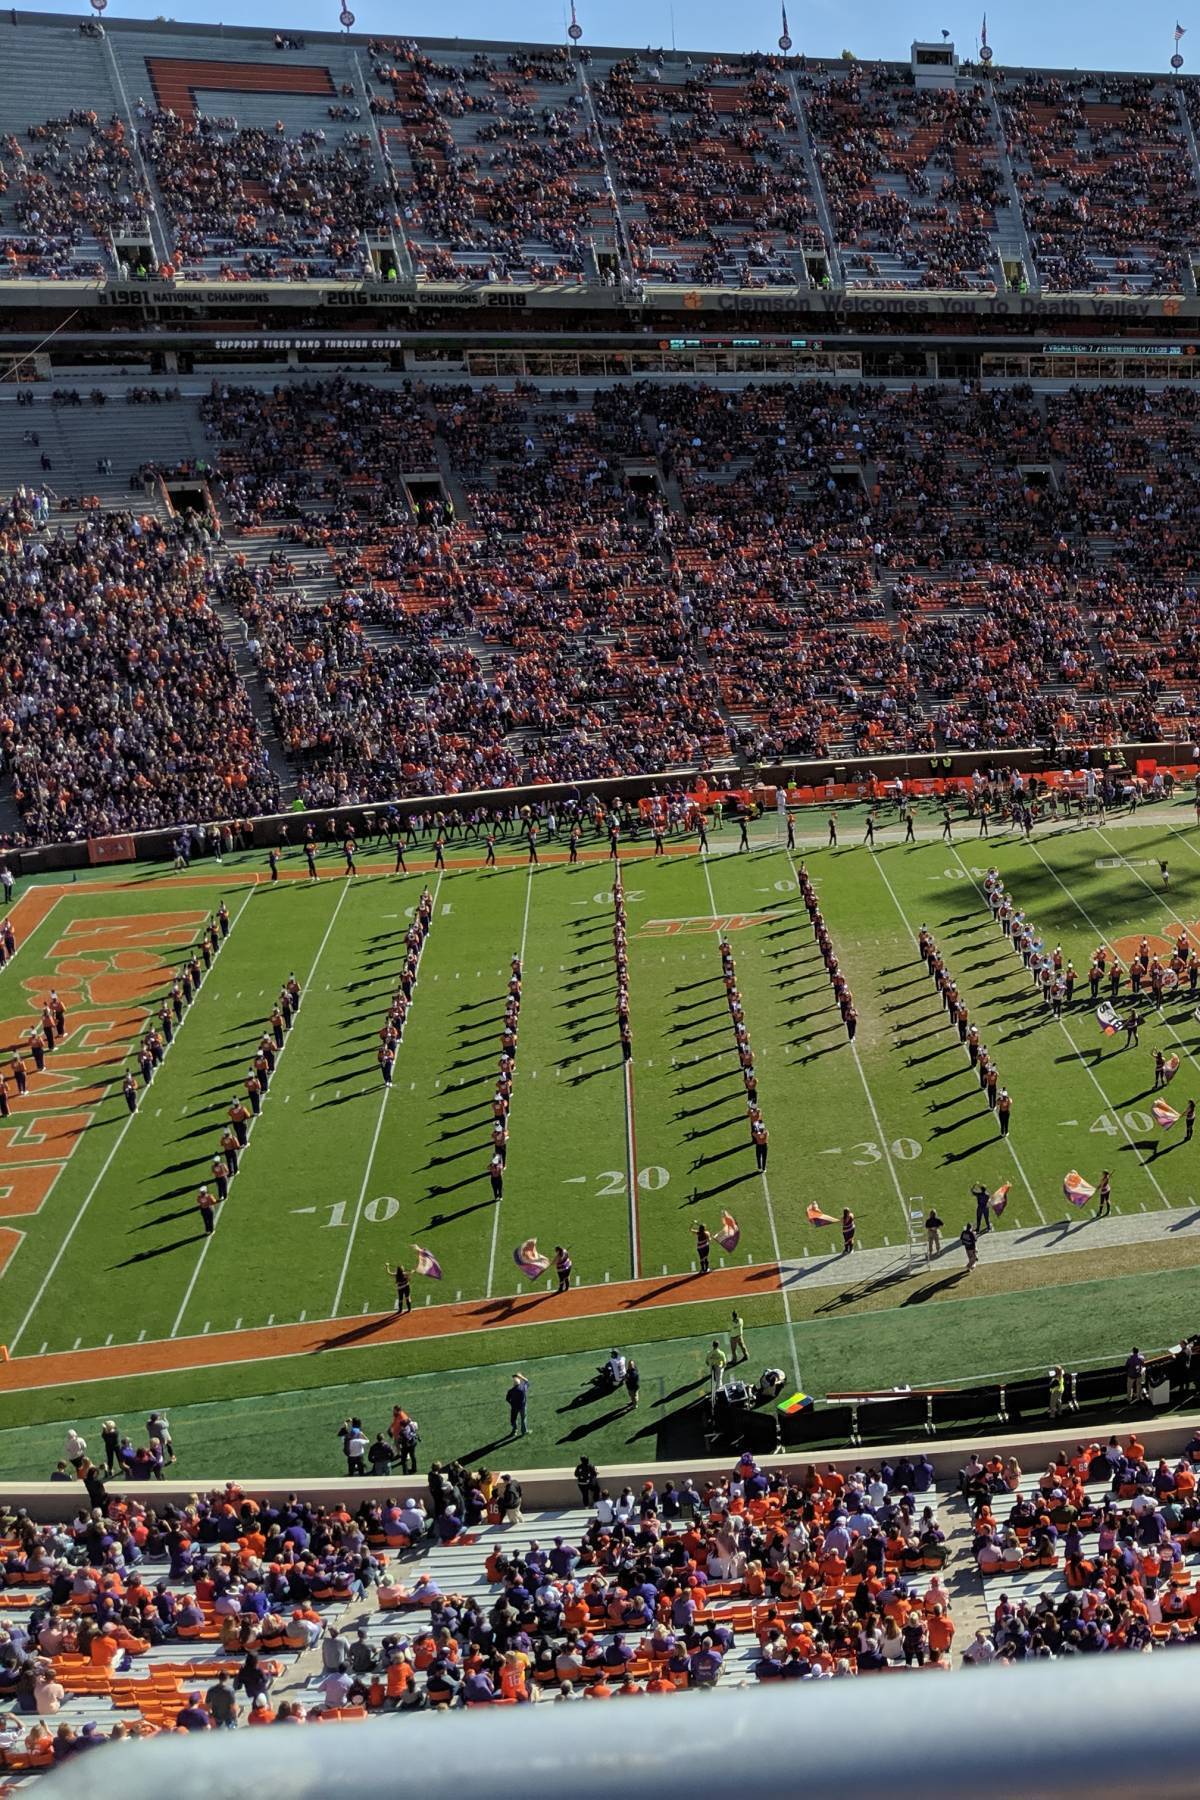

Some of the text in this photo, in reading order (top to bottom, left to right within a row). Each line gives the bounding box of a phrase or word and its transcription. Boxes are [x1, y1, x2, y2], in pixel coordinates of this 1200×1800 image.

[110, 290, 270, 305] 1981 NATIONAL CHAMPIONS
[327, 291, 478, 305] 2016 NATIONAL CHAMPIONS
[487, 292, 527, 306] 2018
[717, 293, 1150, 319] Clemson Welcomes You To Death Valley
[215, 340, 259, 349] SUPPORT
[263, 340, 291, 349] TIGER
[295, 340, 320, 349] BAND
[324, 340, 368, 349] THROUGH
[1089, 1111, 1154, 1137] 40
[850, 1138, 923, 1166] 30
[594, 1166, 671, 1198] 20
[319, 1196, 400, 1228] 10
